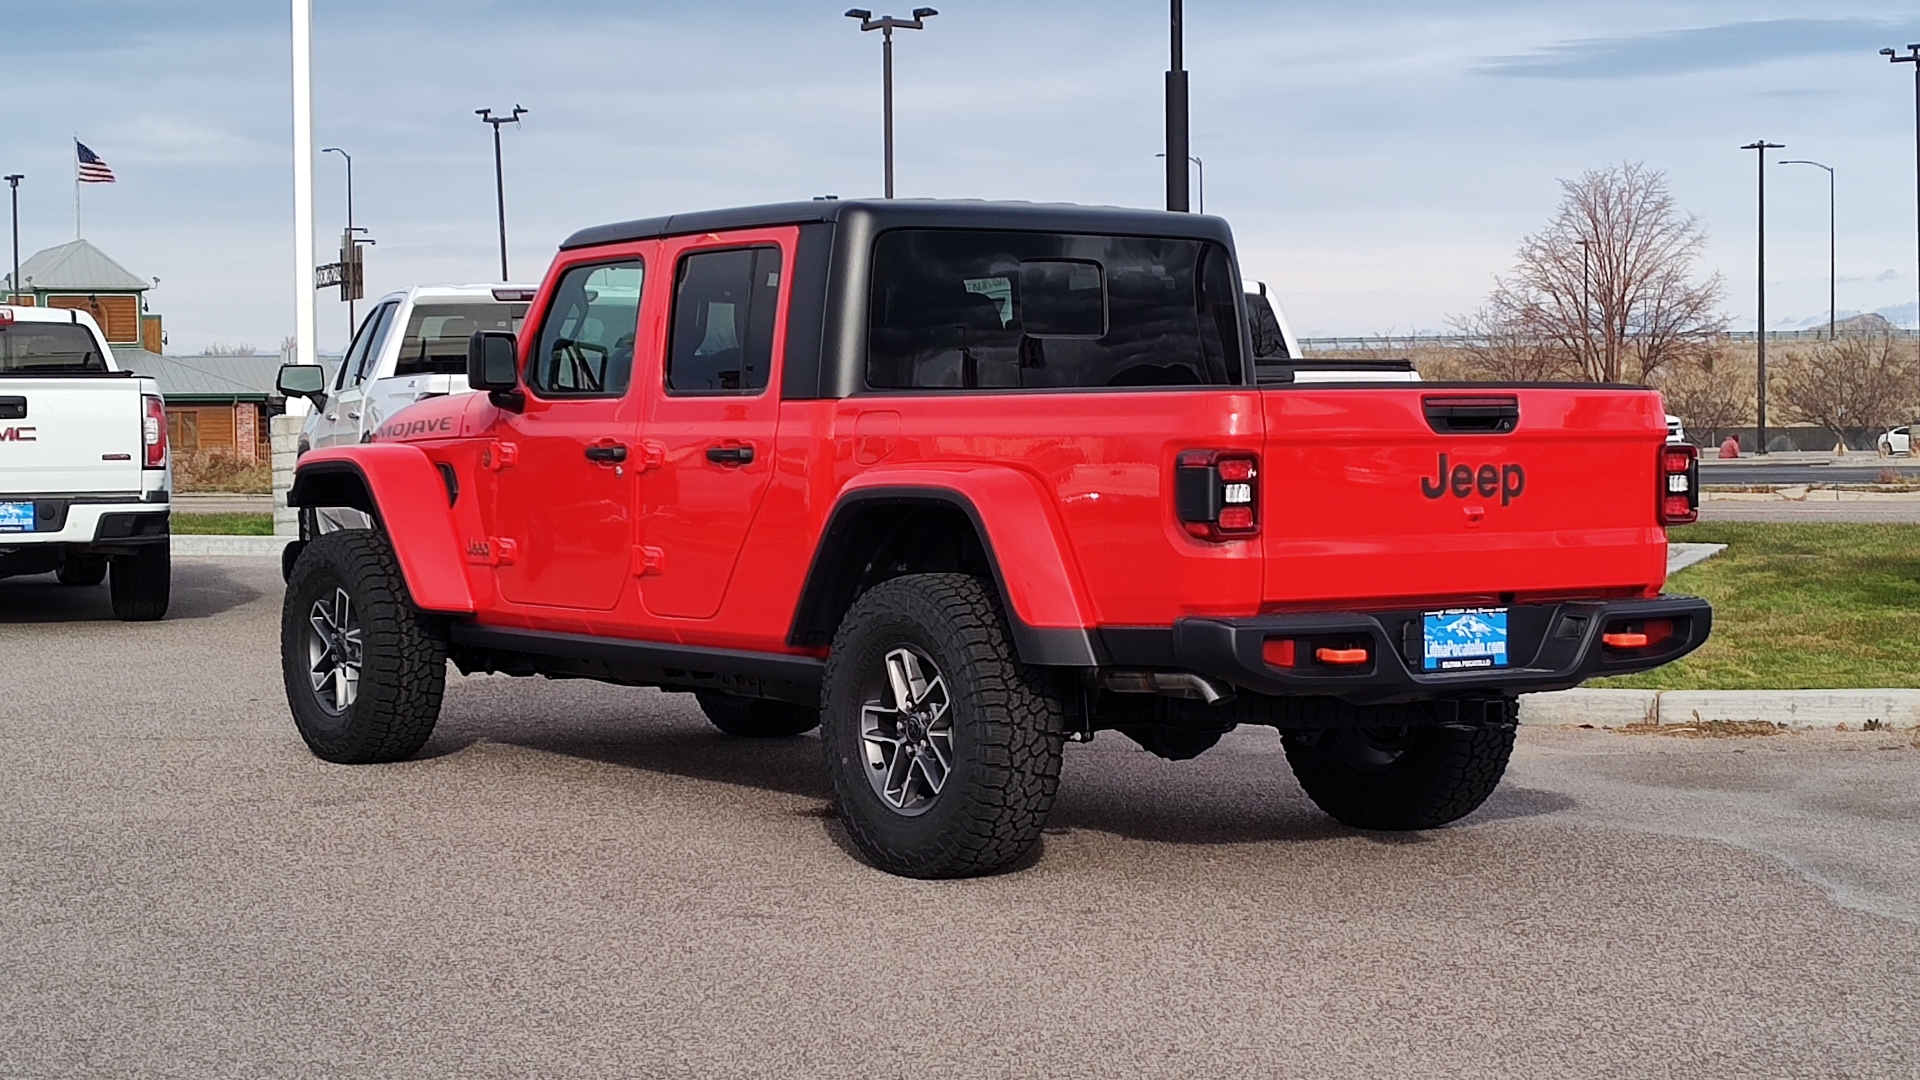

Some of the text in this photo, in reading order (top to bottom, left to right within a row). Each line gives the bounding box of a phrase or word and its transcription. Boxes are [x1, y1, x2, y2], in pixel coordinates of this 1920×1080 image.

[378, 416, 453, 439] MOJAVE
[1420, 453, 1525, 506] Jeep
[465, 537, 489, 559] Jeep
[1424, 638, 1505, 658] LithiaPocatello.com
